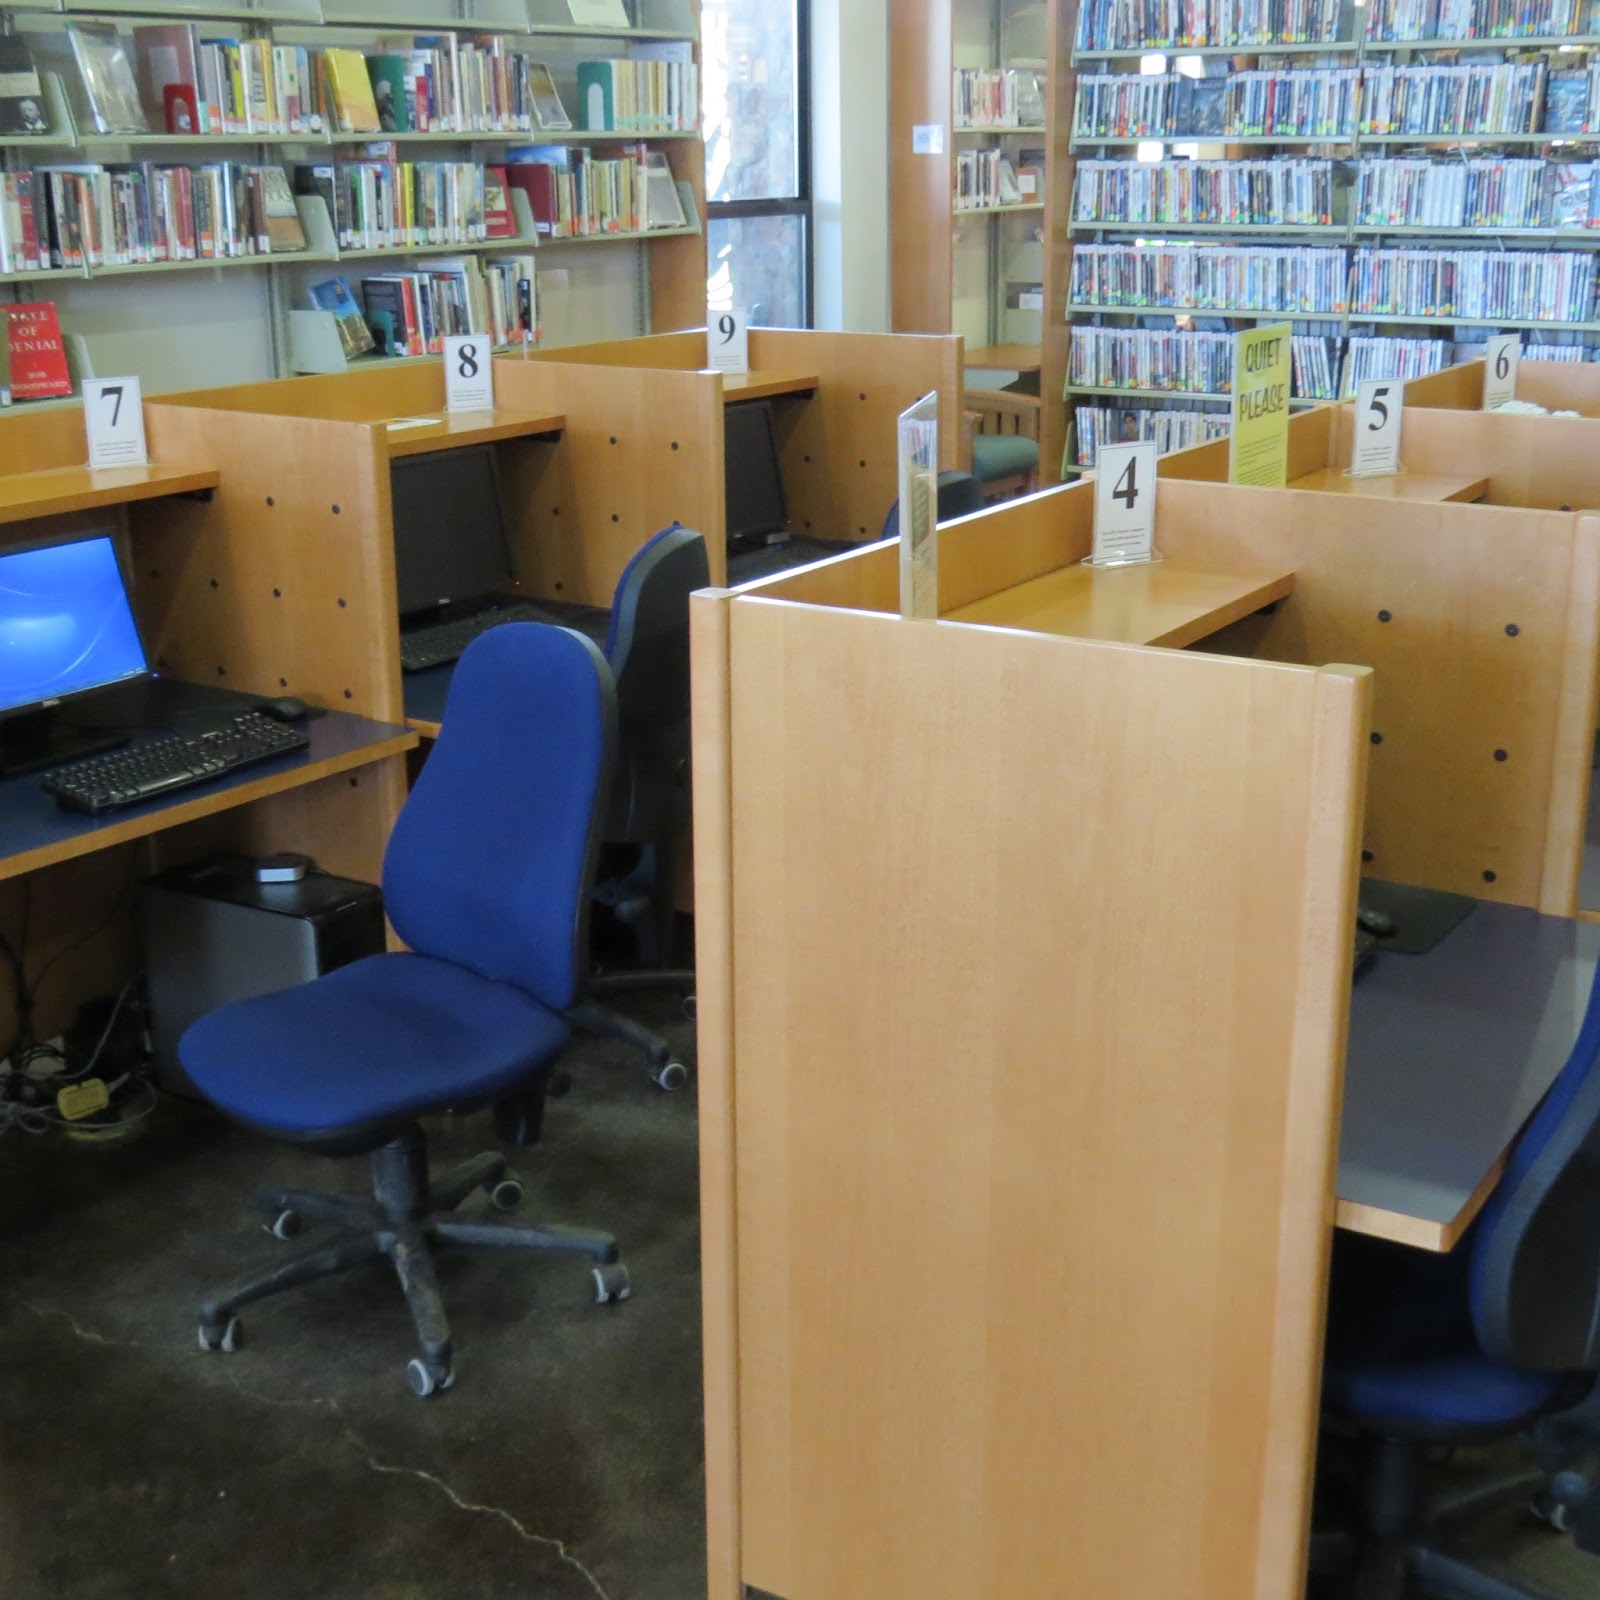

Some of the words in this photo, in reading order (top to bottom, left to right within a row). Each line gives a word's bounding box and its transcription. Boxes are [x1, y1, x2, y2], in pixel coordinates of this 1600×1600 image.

[18, 326, 37, 337] OF
[718, 314, 736, 346] 9
[458, 343, 478, 379] 8
[1245, 337, 1282, 373] QUIET
[1495, 342, 1511, 380] 6
[99, 386, 124, 428] 7
[1239, 384, 1285, 423] PLEASE
[1368, 387, 1390, 431] 5
[1112, 455, 1139, 509] 4
